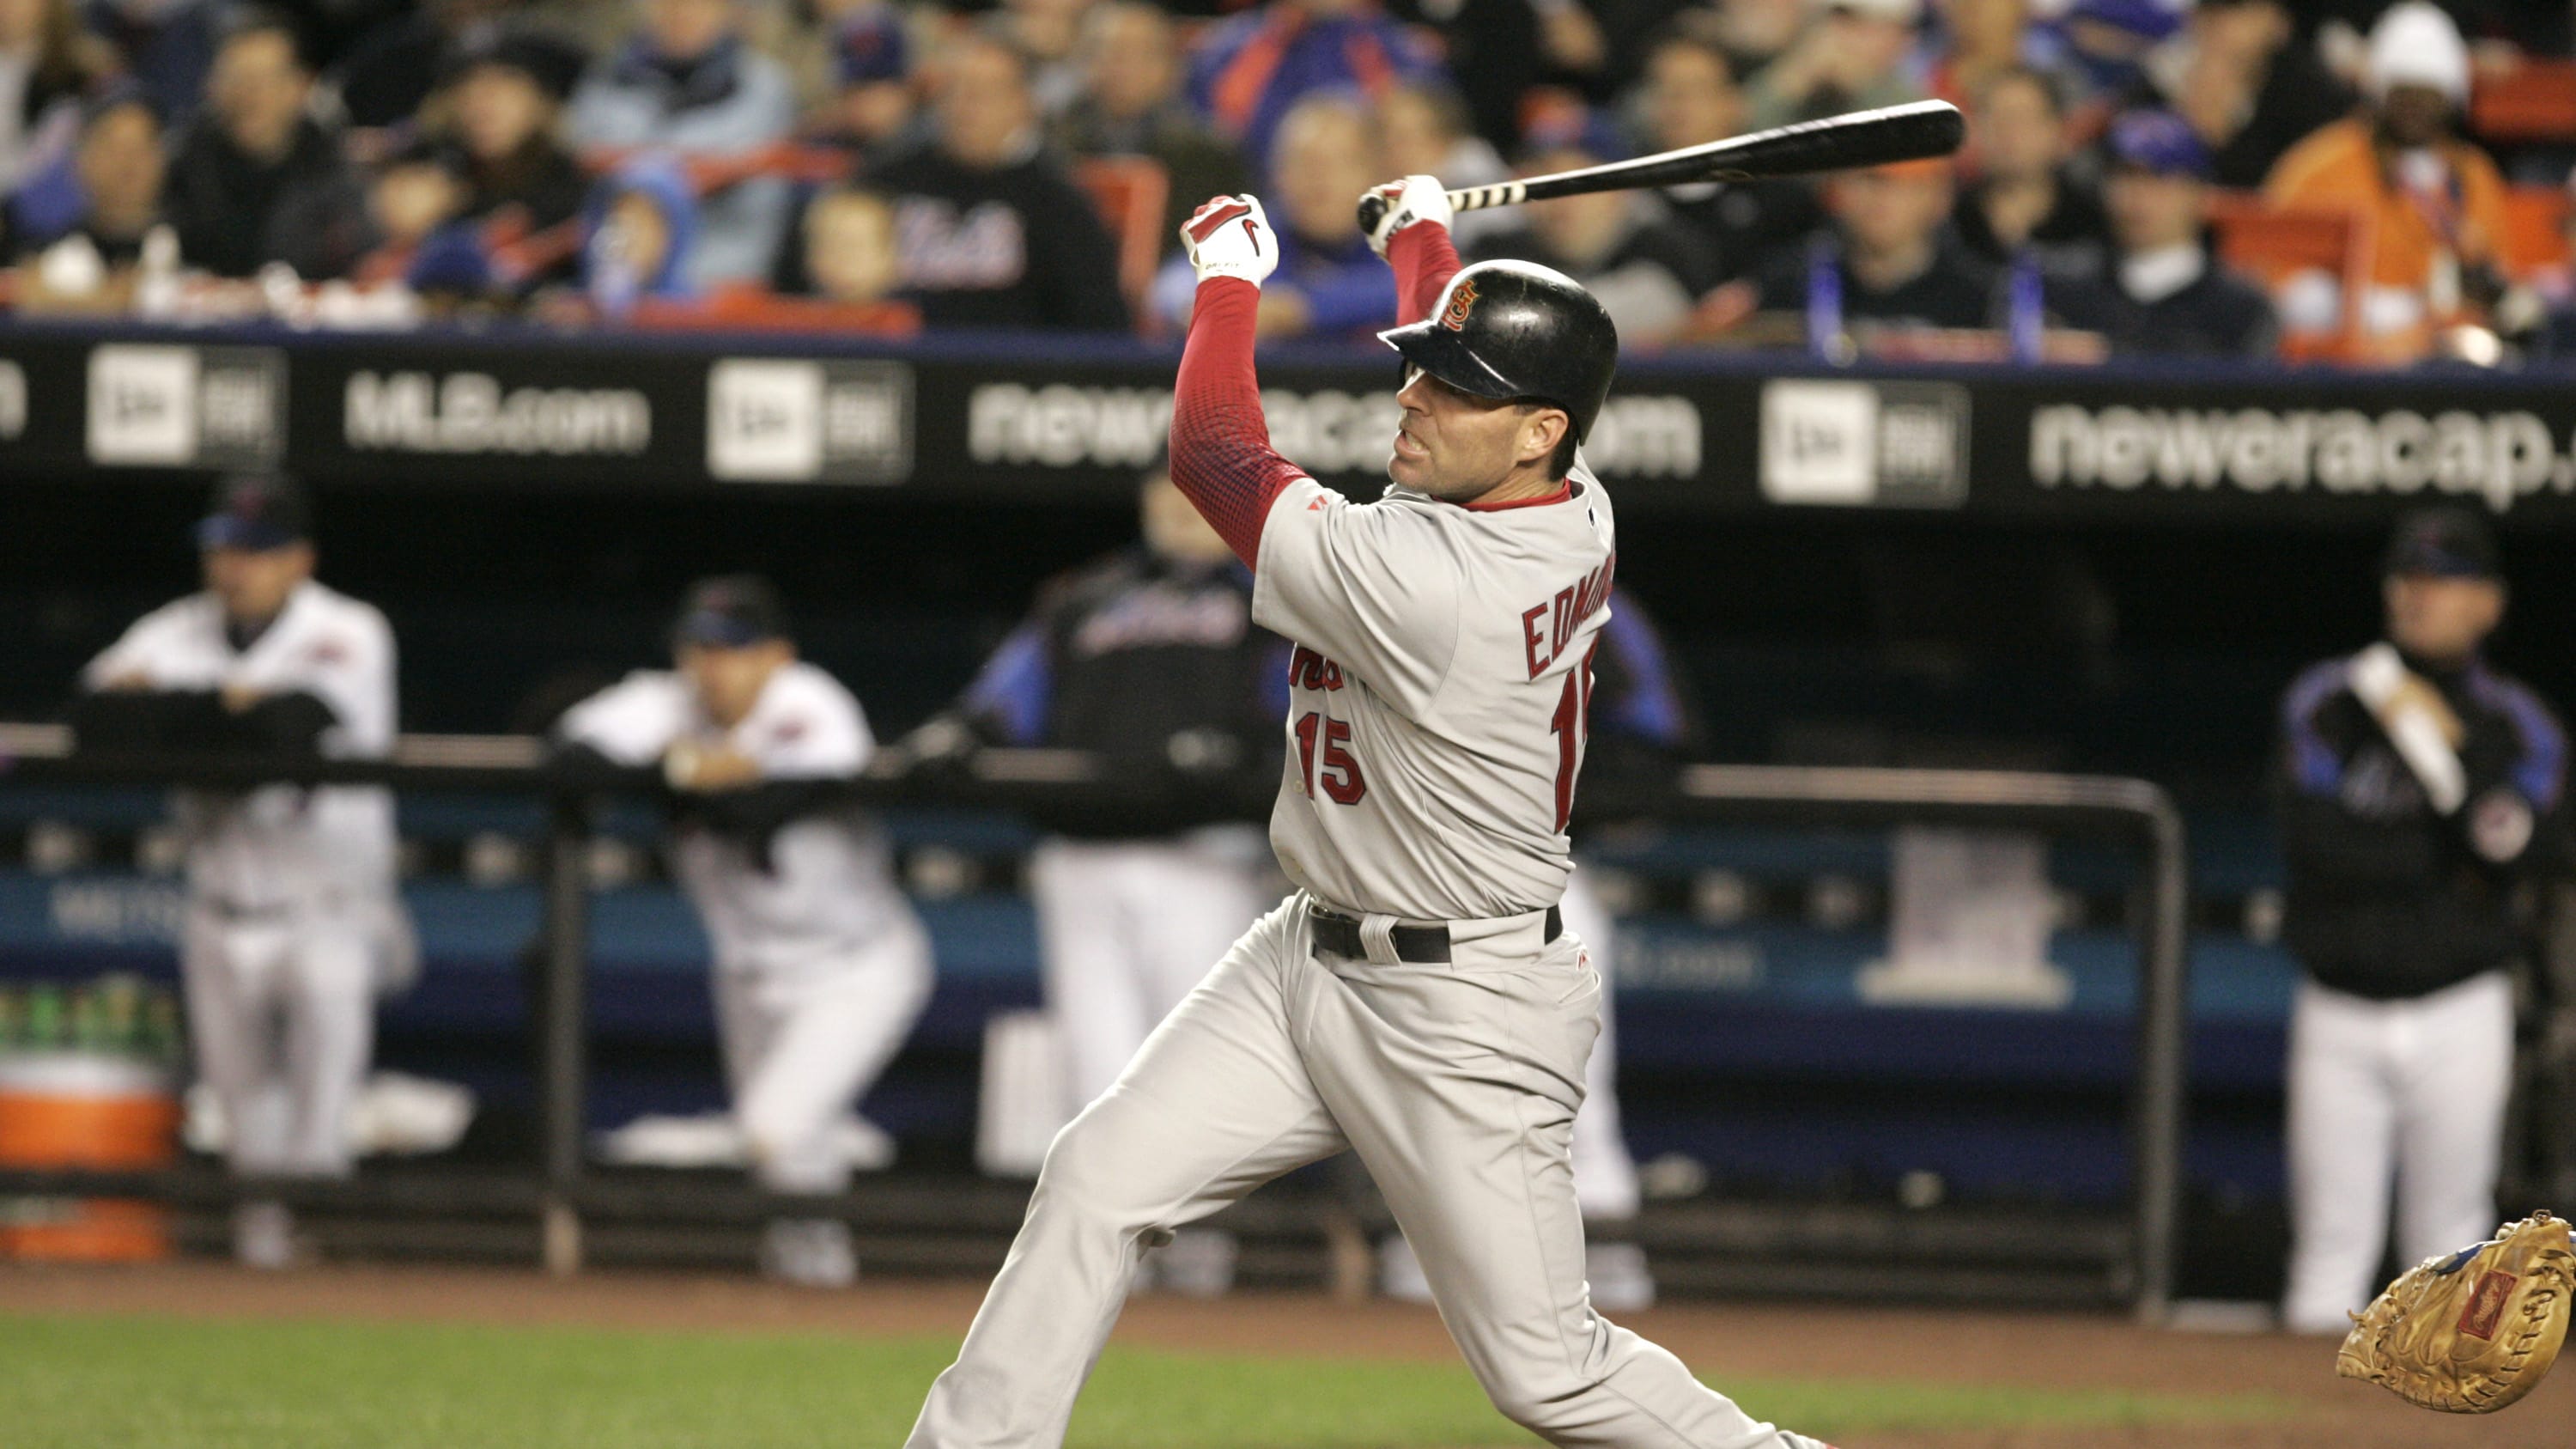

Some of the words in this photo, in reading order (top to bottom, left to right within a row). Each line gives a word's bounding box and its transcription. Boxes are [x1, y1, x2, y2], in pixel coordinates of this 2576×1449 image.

[345, 370, 652, 454] MLB.com
[2029, 405, 2576, 514] neweracap.
[1295, 711, 1367, 806] 15
